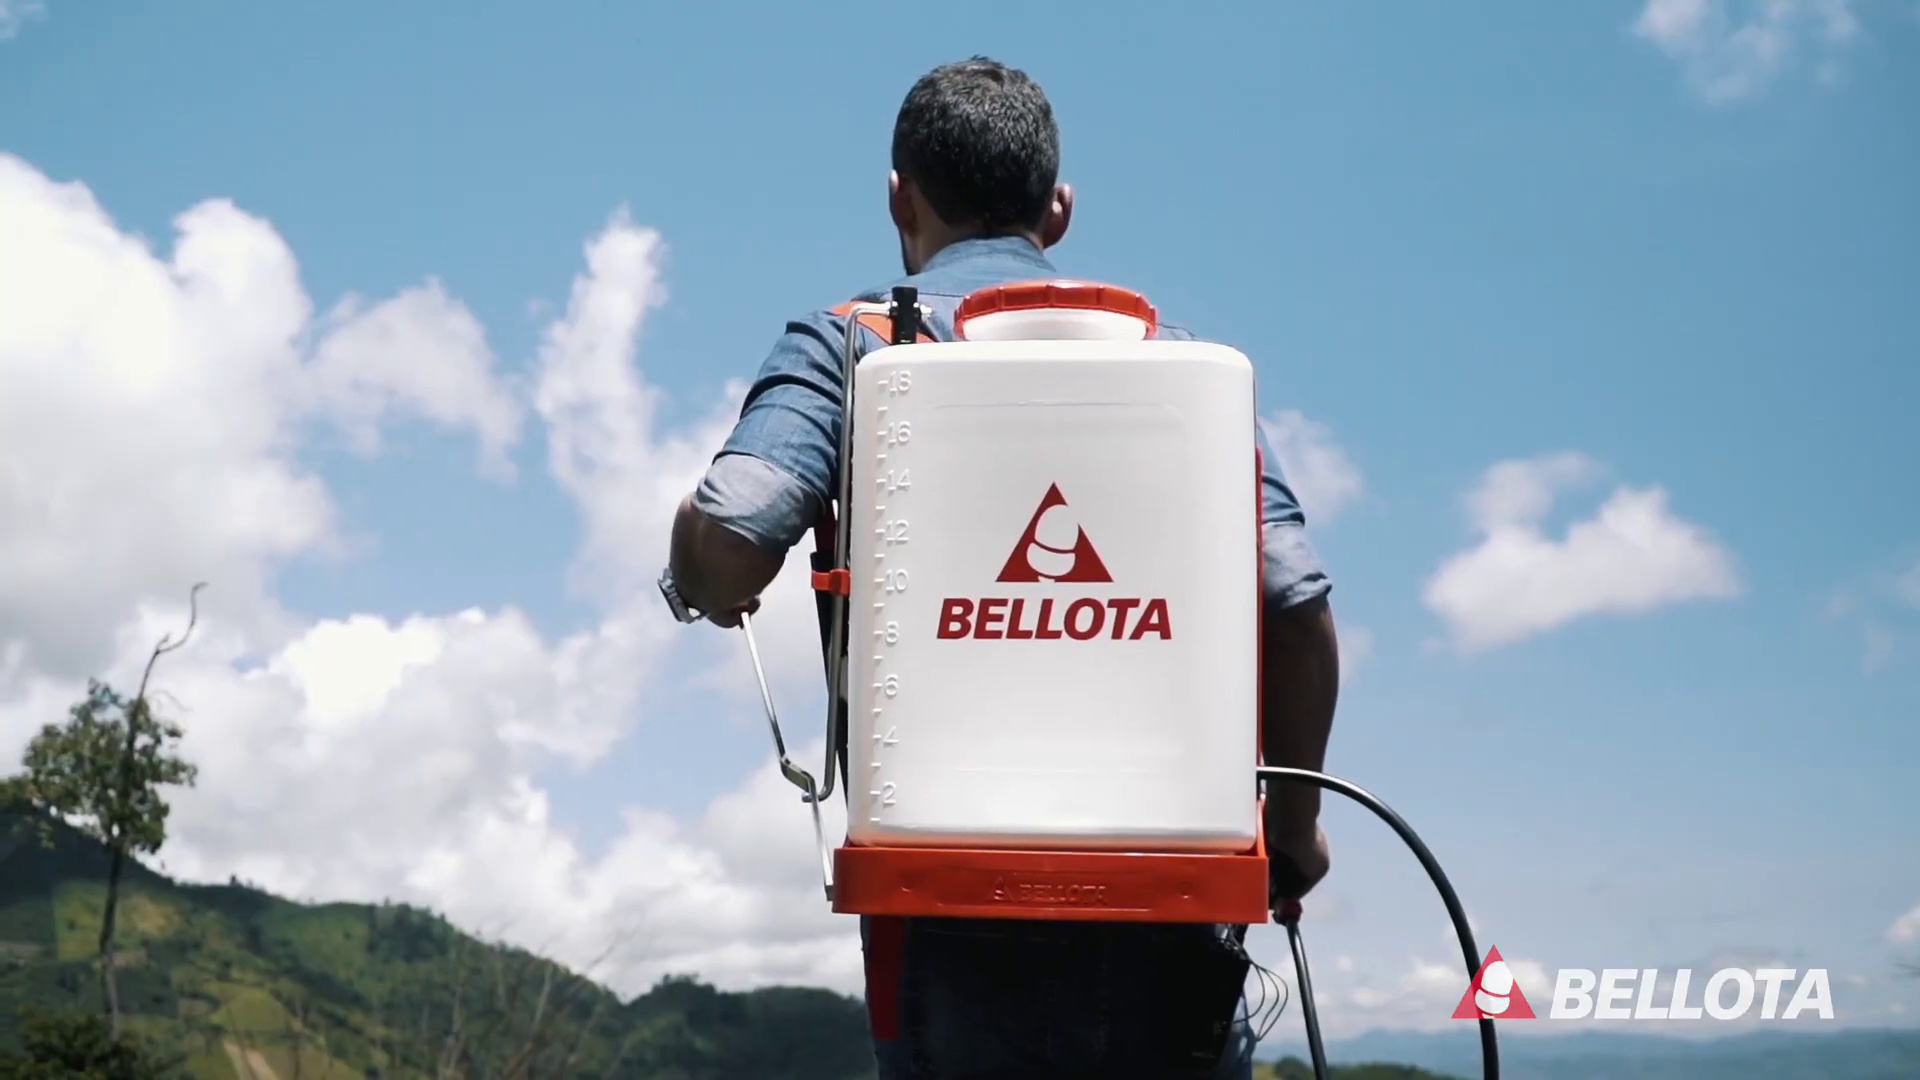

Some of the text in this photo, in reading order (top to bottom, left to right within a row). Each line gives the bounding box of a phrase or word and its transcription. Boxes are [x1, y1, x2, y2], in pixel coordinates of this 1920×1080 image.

[890, 370, 911, 392] 18
[888, 421, 911, 443] 16
[887, 468, 912, 491] 14
[886, 519, 909, 541] 12
[885, 568, 909, 591] 10
[936, 597, 1172, 641] BELLOTA
[1018, 884, 1108, 905] BELLOTA
